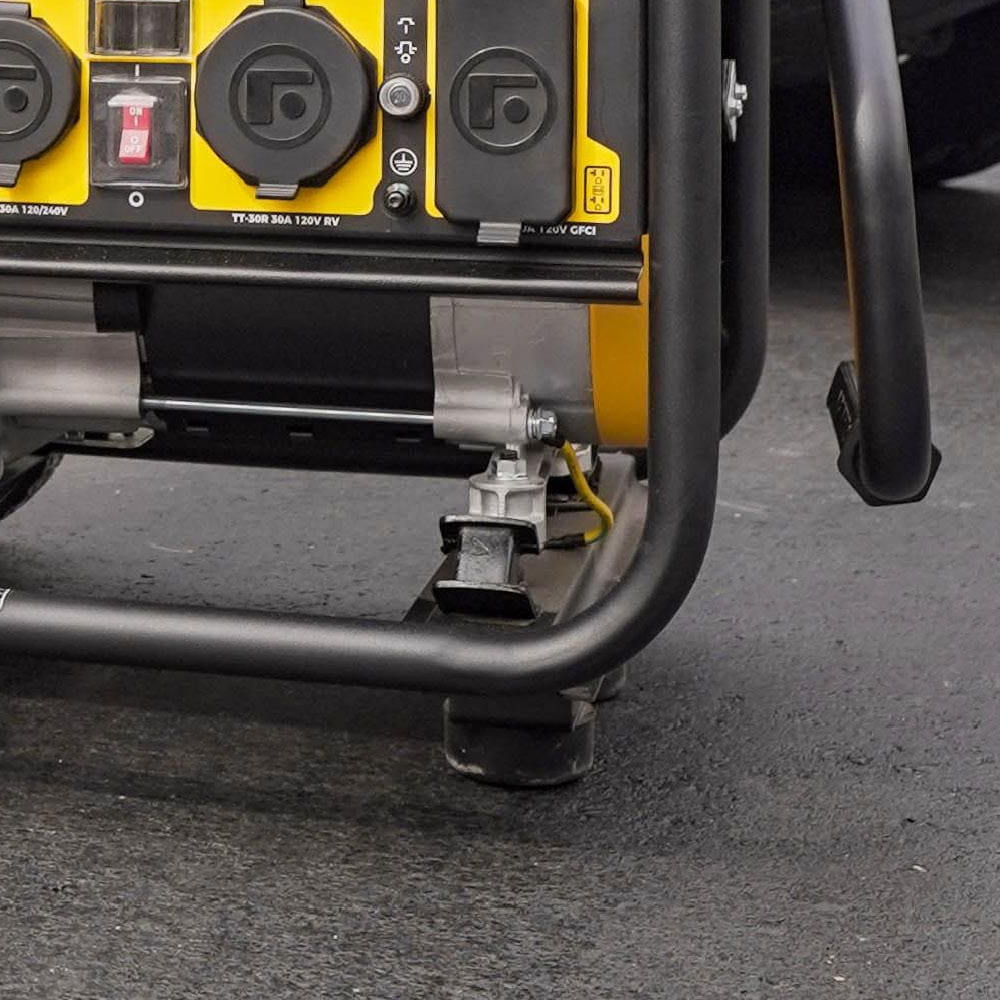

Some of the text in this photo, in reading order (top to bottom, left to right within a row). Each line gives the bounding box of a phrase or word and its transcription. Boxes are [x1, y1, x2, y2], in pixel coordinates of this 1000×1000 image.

[22, 205, 69, 216] 120/240V
[231, 213, 340, 227] TT-30R 30A 120V RV
[569, 225, 597, 236] GFCI
